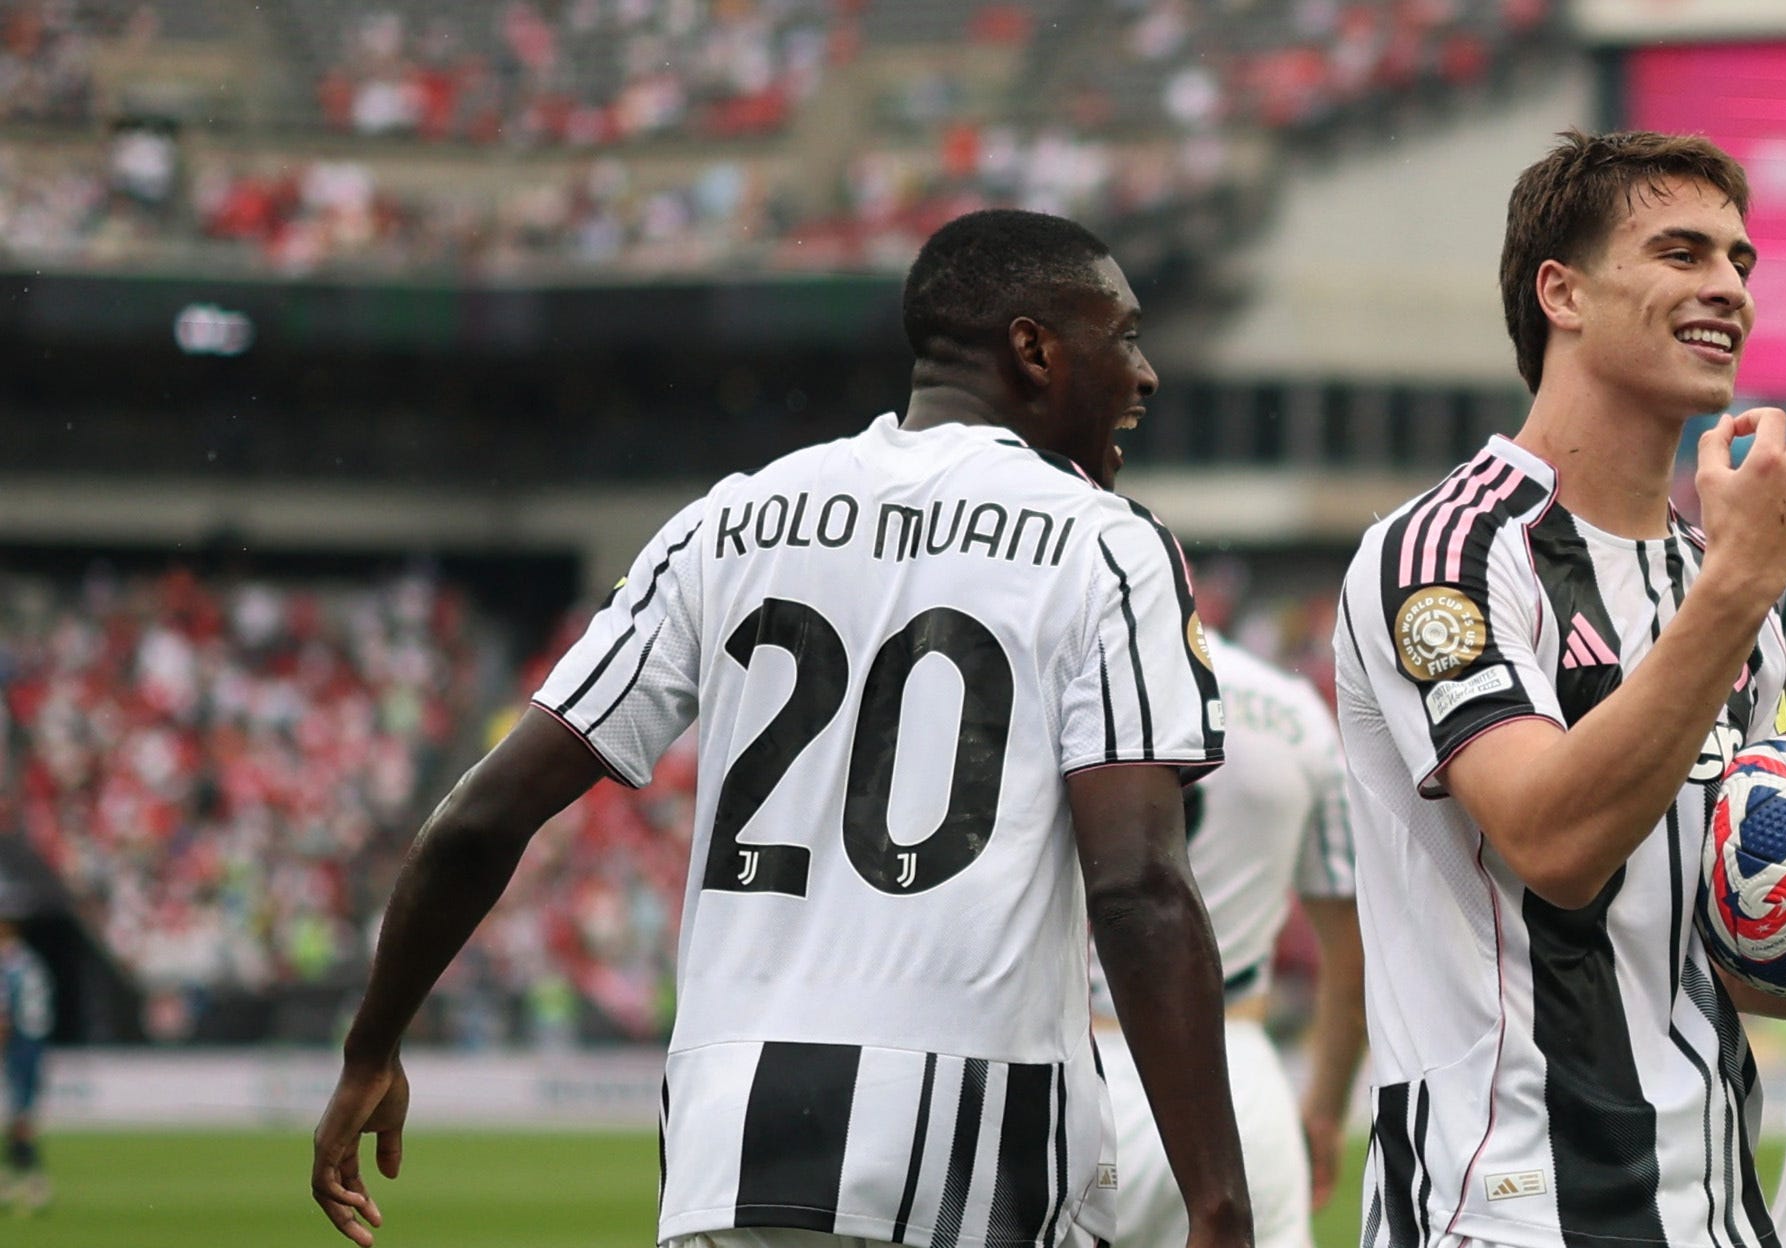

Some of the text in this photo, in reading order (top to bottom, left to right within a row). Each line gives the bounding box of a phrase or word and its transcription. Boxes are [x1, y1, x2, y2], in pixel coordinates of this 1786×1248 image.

[715, 492, 1076, 566] KOLO MUANI
[1401, 597, 1476, 666] CLUB WORLD CUP 25 USA
[1427, 654, 1461, 677] FIFA
[701, 597, 1015, 898] 20
